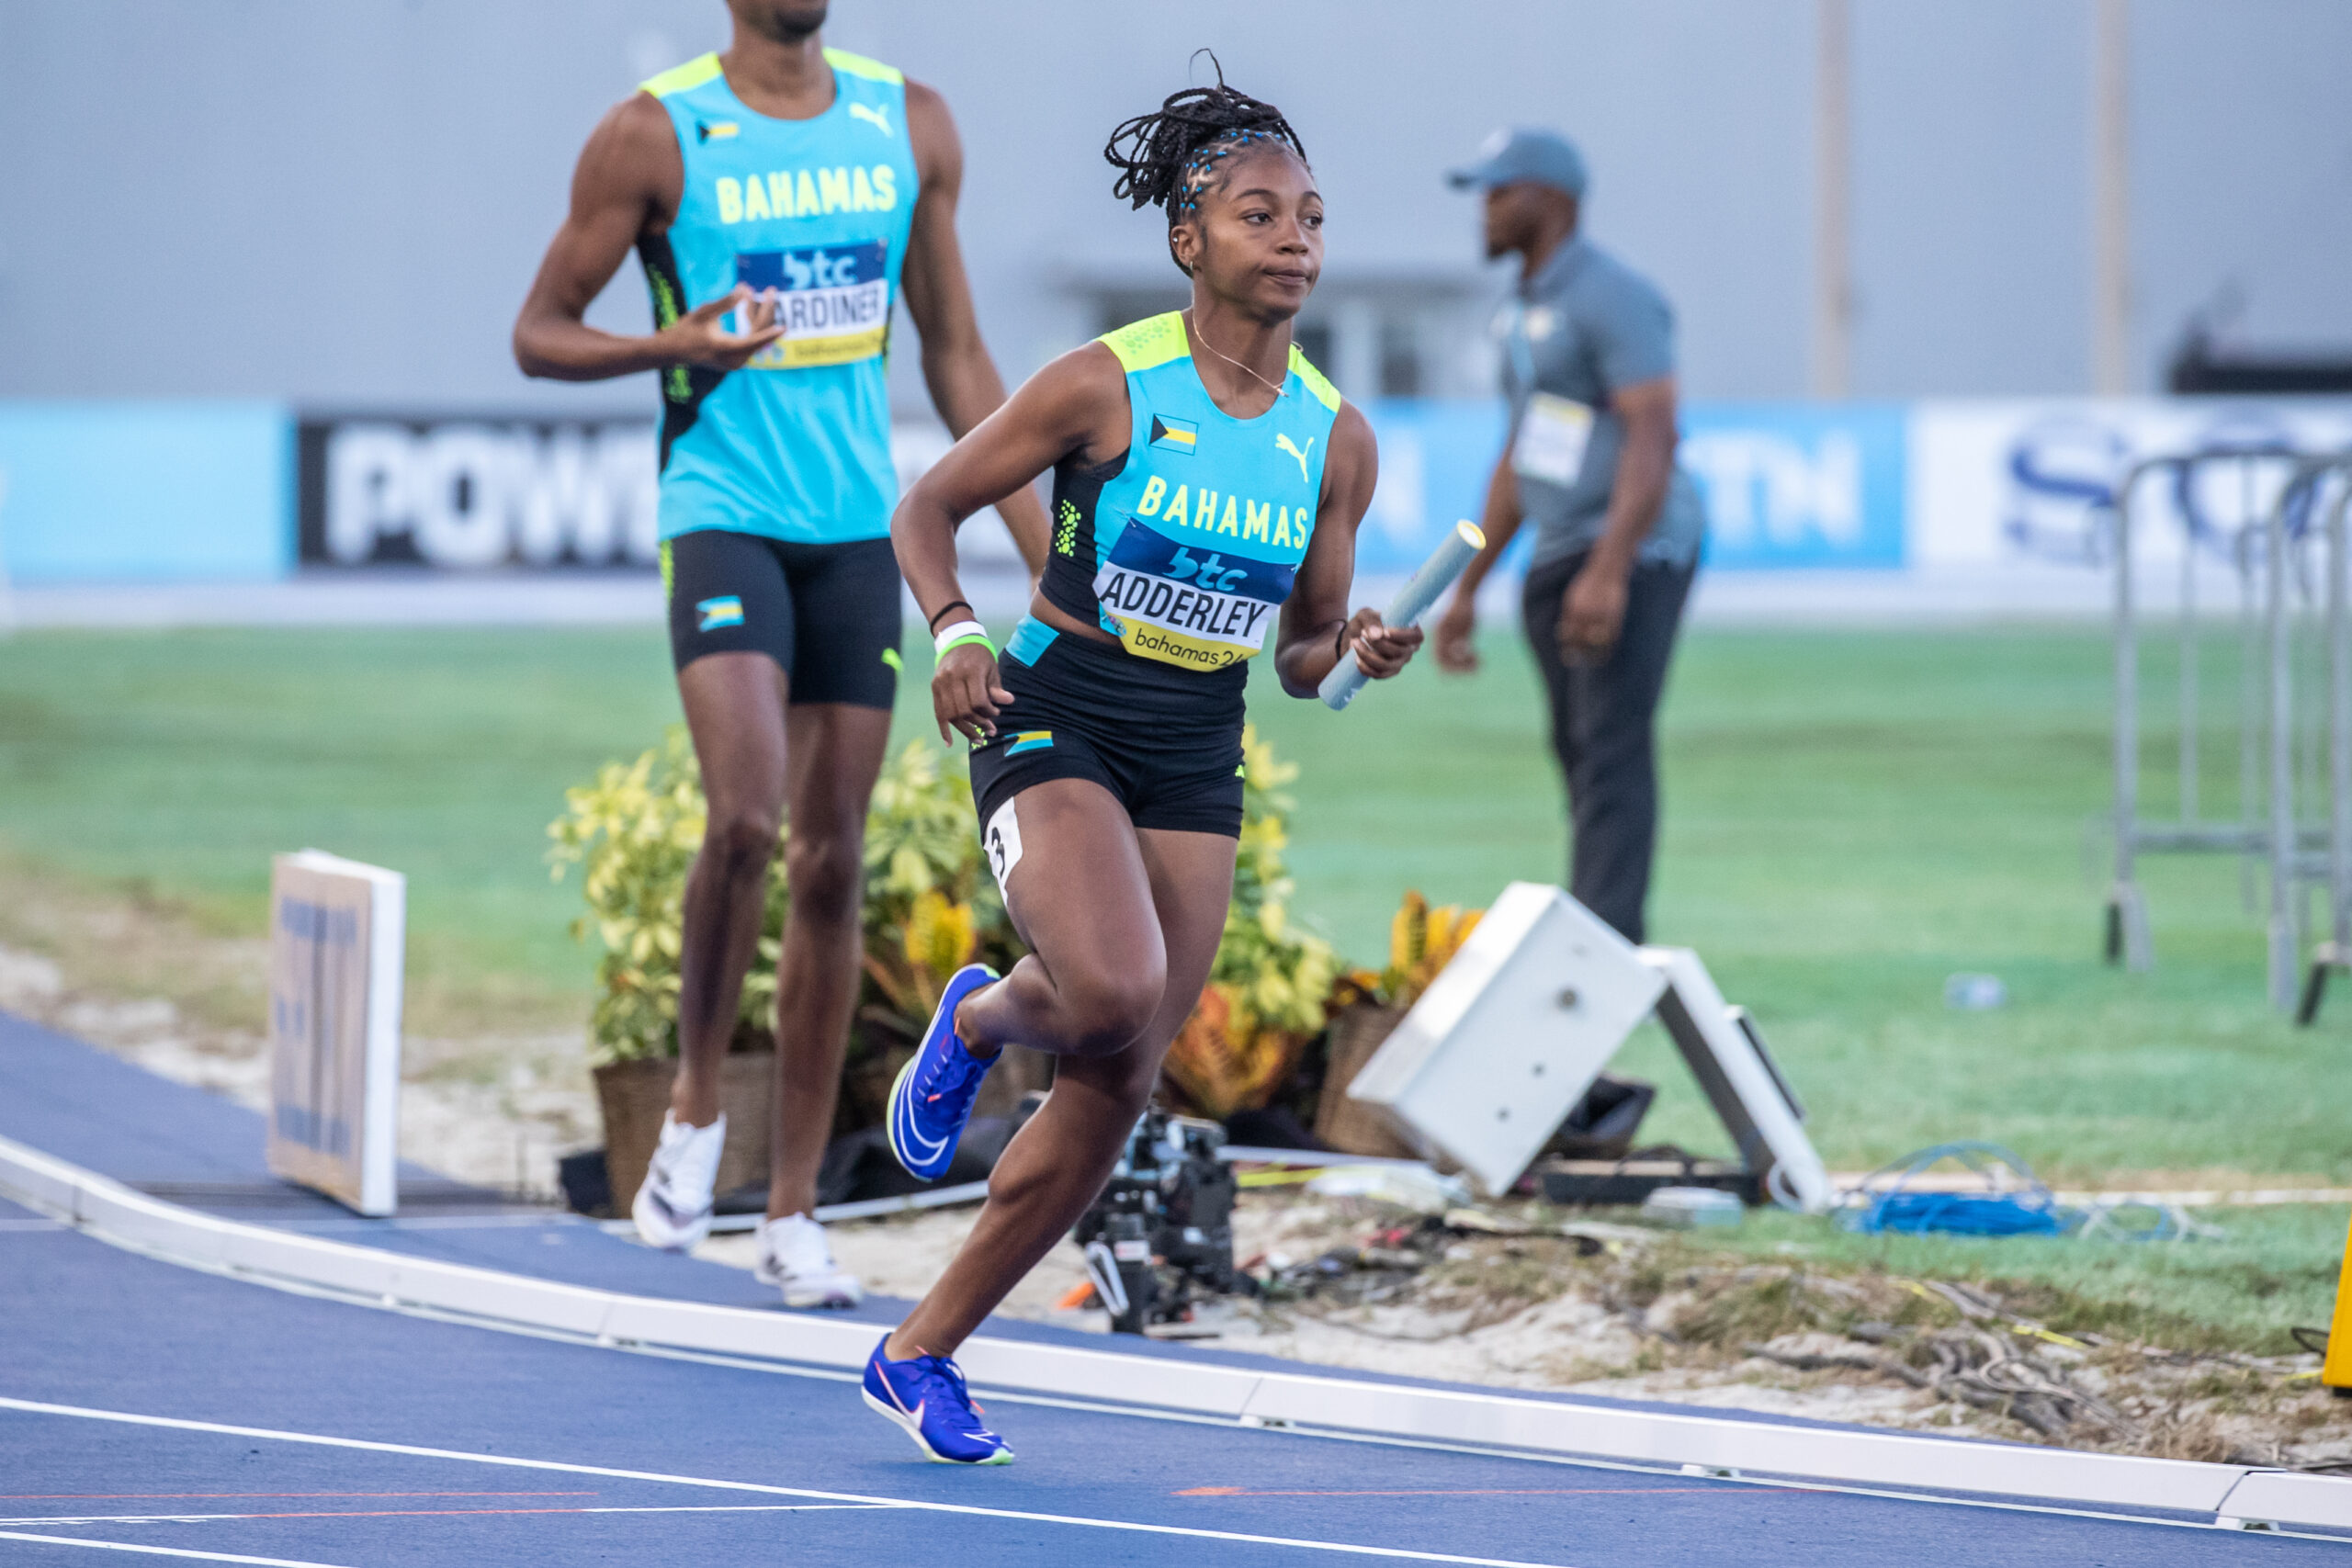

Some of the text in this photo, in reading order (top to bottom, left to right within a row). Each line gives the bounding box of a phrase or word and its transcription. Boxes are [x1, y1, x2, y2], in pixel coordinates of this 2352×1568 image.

[716, 164, 898, 224] BAHAMAS
[782, 249, 858, 289] btc
[772, 288, 879, 329] ARDINER
[1136, 475, 1308, 549] BAHAMAS
[1161, 547, 1248, 592] btc
[1101, 572, 1268, 637] ADDERLEY
